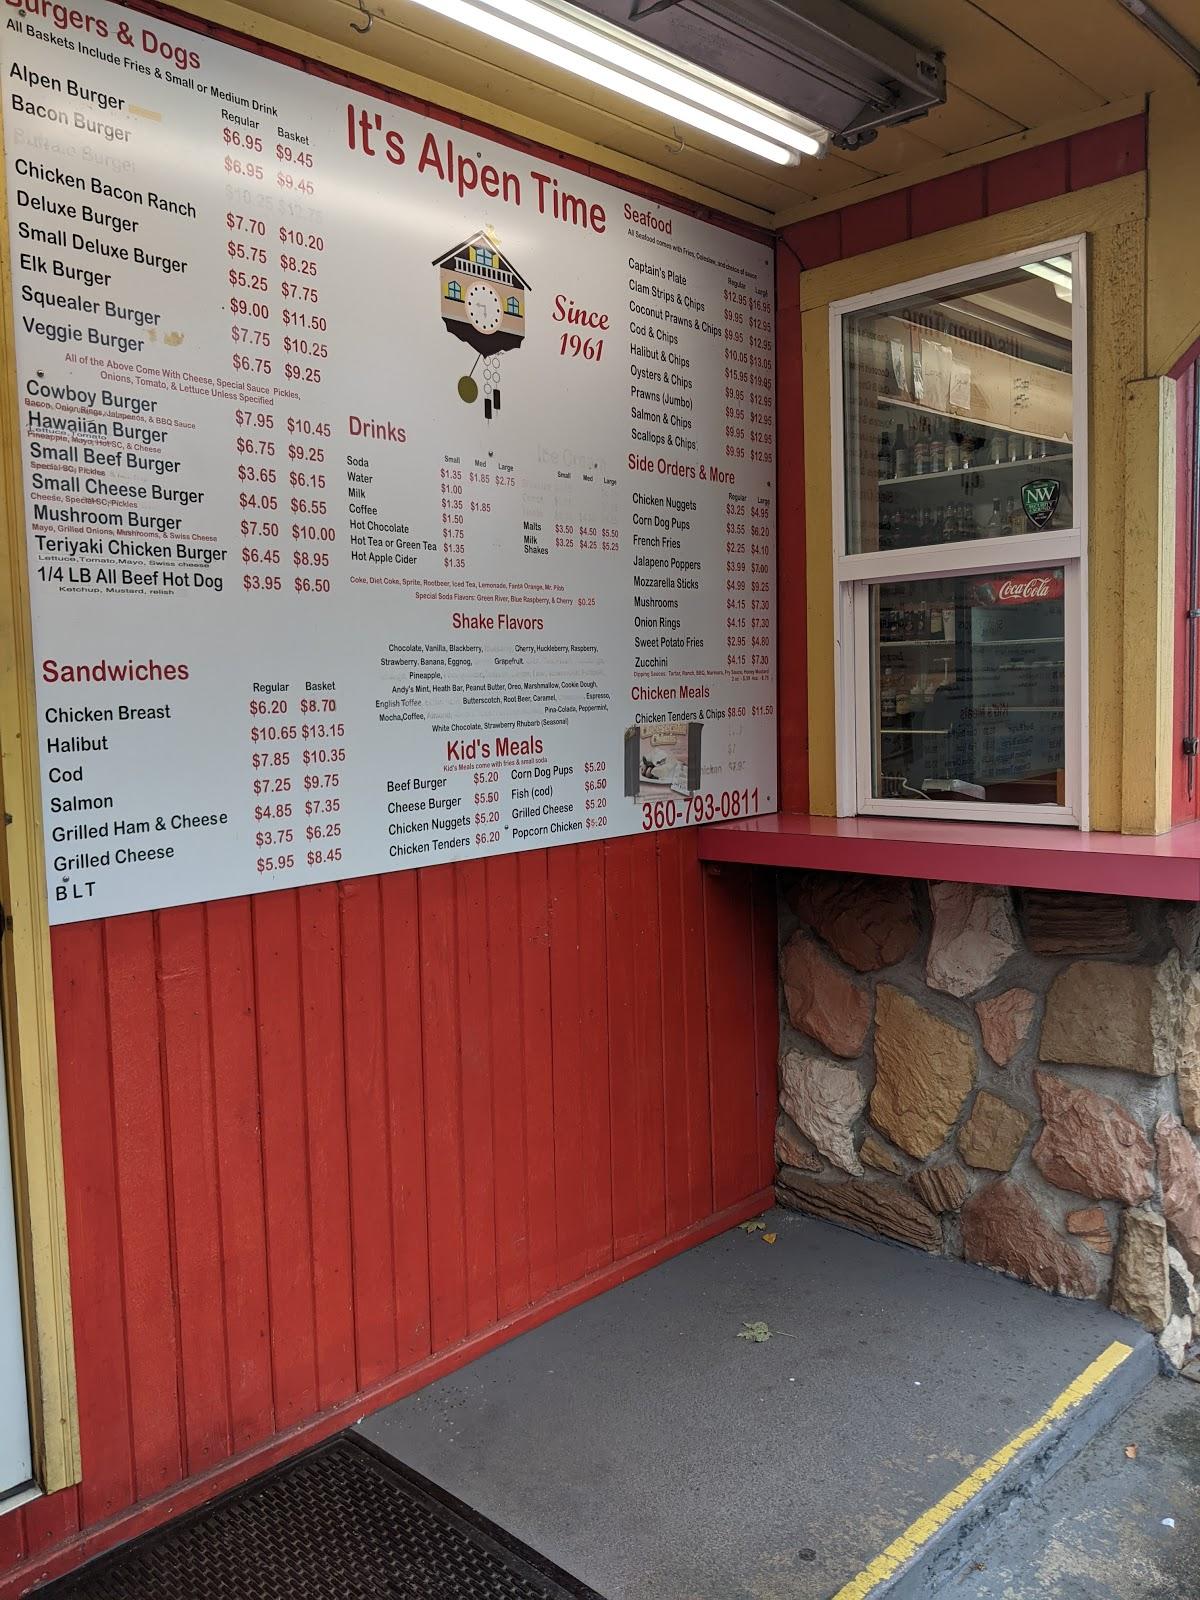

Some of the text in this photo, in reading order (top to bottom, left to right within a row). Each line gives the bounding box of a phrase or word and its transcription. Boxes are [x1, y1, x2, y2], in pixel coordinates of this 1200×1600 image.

[117, 22, 134, 47] &
[142, 29, 201, 70] Dogs
[7, 18, 277, 116] All Baskets Include Fries & Small or Medium Drink
[10, 62, 312, 168] Alpen Burger $6.95 $9.45
[222, 109, 309, 145] Regular Basket
[348, 104, 606, 233] It's Alpen Time
[16, 159, 85, 190] Chicken
[92, 178, 142, 204] Bacon
[148, 192, 196, 218] Ranch
[227, 212, 265, 236] $7.70
[280, 226, 323, 251] $10.20
[624, 203, 672, 236] Seafood
[629, 258, 665, 279] Captain's
[668, 270, 686, 285] Plate
[21, 254, 326, 331] Elk Burger $9.00 $11.50
[22, 285, 327, 358] Squealer Burger $7.75 $10.25
[552, 295, 609, 330] Since
[630, 300, 663, 320] Coconut
[665, 311, 692, 328] Prawns
[695, 319, 700, 330] &
[702, 322, 722, 337] Chips
[23, 316, 320, 383] Veggie Burger $6.75 $9.25
[561, 333, 603, 361] 1961
[171, 382, 177, 390] &
[179, 384, 209, 395] Lettuce
[212, 389, 237, 400] Unless
[239, 393, 274, 406] Specified
[631, 386, 692, 410] Prawns (Jumbo)
[27, 380, 330, 437] Cowboy Burger $7.95 $10.45
[350, 416, 406, 442] Drinks
[30, 442, 78, 462] Small
[84, 448, 122, 466] Beef
[127, 451, 180, 474] Burger
[238, 464, 276, 483] $3.65
[290, 471, 325, 488] $6.15
[347, 456, 515, 486] Soda $1.35 $1.85 $2.75
[628, 454, 735, 484] Side Orders & More
[633, 493, 664, 506] Chicken
[666, 497, 696, 512] Nuggets
[1026, 486, 1054, 503] NW
[349, 504, 463, 524] Coffee $1.50
[350, 520, 464, 538] Hot Chocolate $1.75
[524, 521, 618, 538] Malts $3.50 $4.50 $5.50
[634, 534, 680, 548] French Fries
[38, 566, 330, 593] 1/4 LB All Beef Hot Dog $3.95 $6.50
[999, 578, 1053, 599] Coca-Cola
[453, 613, 543, 630] Shake Flavors
[635, 617, 769, 630] Onion Rings $4.15 $7.30
[43, 660, 188, 682] Sandwiches
[635, 657, 667, 667] Zucchini
[632, 685, 709, 700] Chicken Meals
[46, 699, 336, 723] Chicken Breast $6.20 $8.70
[636, 713, 666, 723] Chicken
[668, 711, 697, 721] Tenders
[699, 710, 704, 719] &
[706, 709, 725, 720] Chips
[752, 705, 773, 716] $11.50
[48, 724, 344, 753] Halibut $10.65 $13.15
[448, 736, 543, 761] Kid's Meals
[49, 749, 345, 782] Cod $7.85 $10.35
[511, 762, 605, 779] Corn Dog Pups $5.20
[51, 774, 338, 812] Salmon $7.25 $9.75
[53, 799, 340, 842] Grilled Ham & Cheese $4.85 $7.35
[642, 787, 759, 830] 360-793-0811
[389, 811, 499, 835] Chicken Nuggets $5.20
